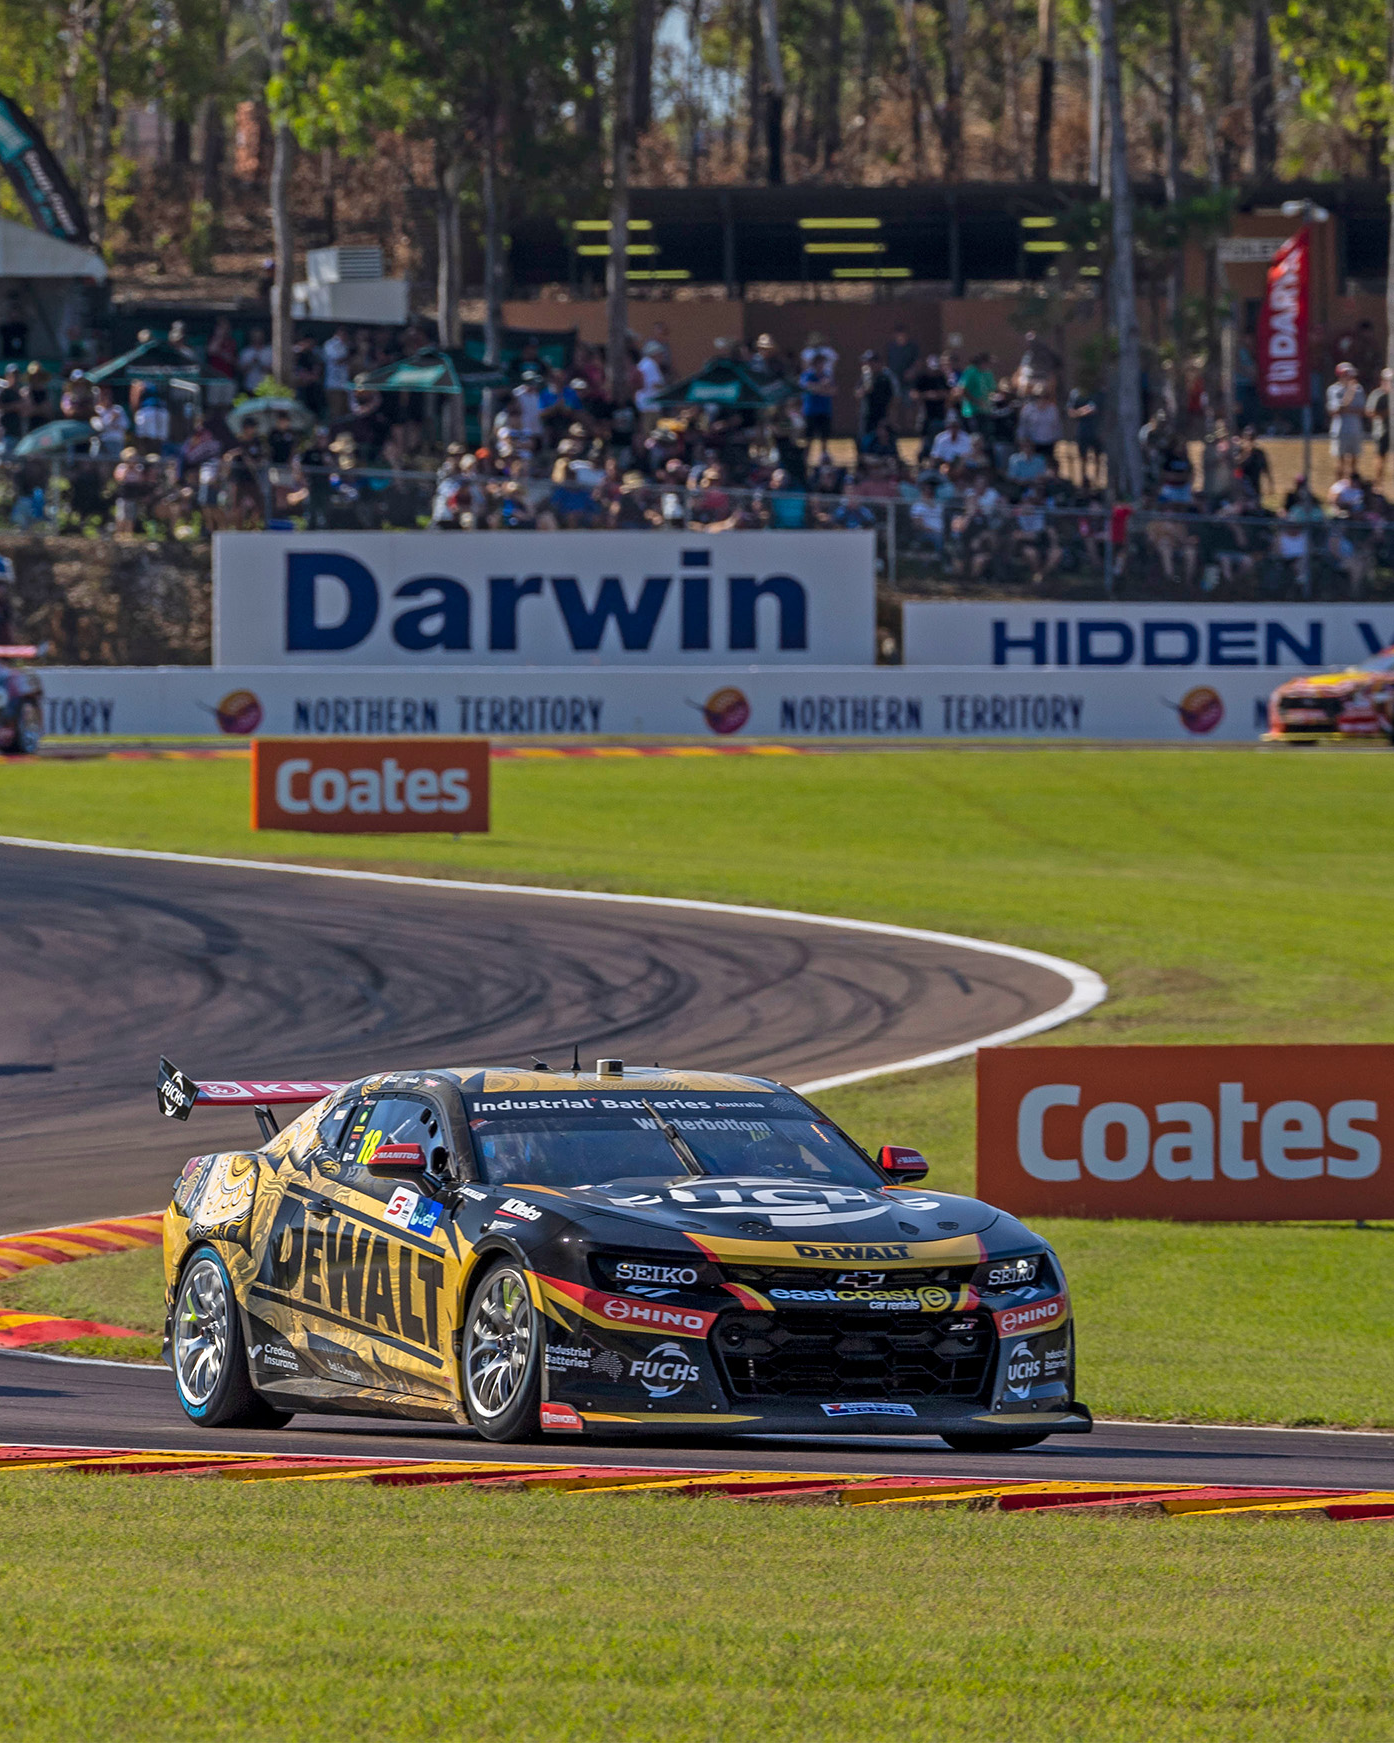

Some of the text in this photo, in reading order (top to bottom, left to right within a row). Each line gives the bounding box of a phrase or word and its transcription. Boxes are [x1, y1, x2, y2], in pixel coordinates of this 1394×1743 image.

[285, 549, 809, 653] Darwin
[992, 620, 1324, 666] HIDDEN
[293, 696, 604, 734] NORTHERN TERRITORY
[780, 695, 1085, 732] NORTHERN TERRITORY
[275, 756, 471, 815] Coates
[161, 1081, 186, 1107] FUCHS
[473, 1099, 595, 1113] Industrial
[714, 1100, 765, 1109] Australia
[632, 1117, 772, 1133] Wnterbottom
[1017, 1082, 1383, 1182] Coates
[356, 1129, 383, 1165] 18
[378, 1151, 421, 1160] MANITOU
[616, 1262, 698, 1285] SEIKO
[987, 1264, 1037, 1286] SEIKO
[869, 1299, 920, 1310] car rentals
[1018, 1302, 1059, 1325] HINO
[631, 1306, 704, 1330] HINO
[264, 1343, 297, 1360] Credence
[544, 1354, 590, 1369] Batteries
[545, 1344, 592, 1358] Industrial
[264, 1354, 299, 1371] Insurance
[629, 1360, 700, 1382] FUCHS
[1007, 1360, 1041, 1381] UCHS
